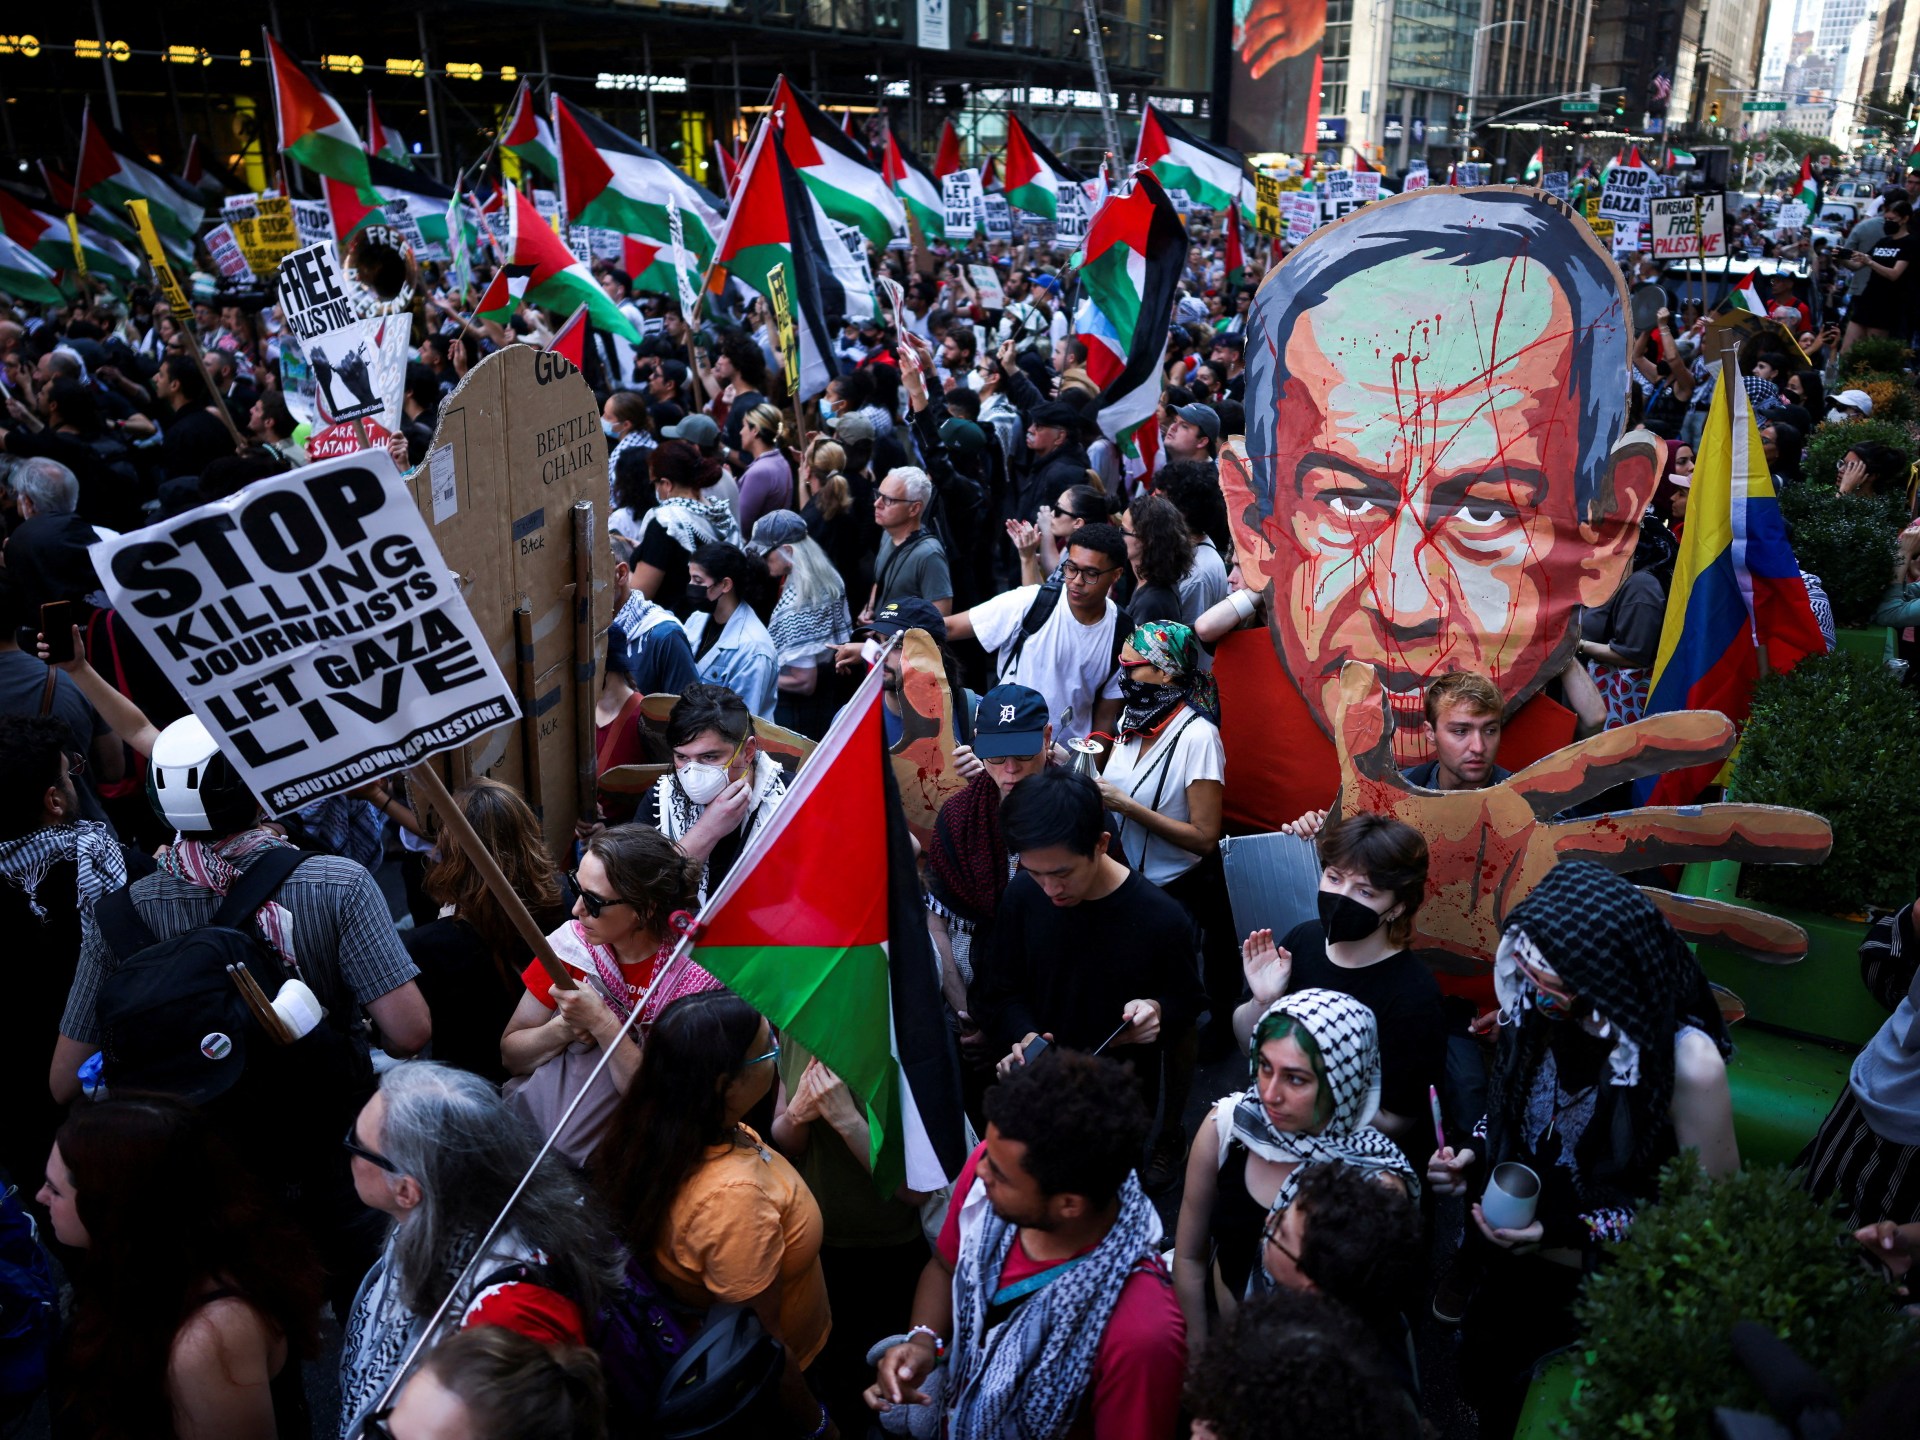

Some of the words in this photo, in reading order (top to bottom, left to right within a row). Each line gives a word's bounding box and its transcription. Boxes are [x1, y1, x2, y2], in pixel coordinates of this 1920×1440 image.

[945, 185, 971, 198] LET
[1331, 180, 1353, 192] STOP
[1605, 184, 1646, 195] STARVING
[1608, 169, 1649, 187] STOP
[946, 211, 971, 227] LIVE
[1602, 194, 1641, 213] GAZA
[1656, 199, 1693, 216] KOREANS
[1705, 198, 1715, 212] A
[365, 226, 410, 260] FREE
[280, 245, 343, 315] FREE
[288, 296, 357, 342] PALESTINE
[536, 410, 598, 458] BEETLE
[542, 442, 594, 486] CHAIR
[110, 467, 386, 619] STOP
[153, 533, 425, 662] KILLING
[186, 571, 438, 687] JOURNALISTS
[204, 664, 304, 732] LET
[313, 608, 465, 690] GAZA
[228, 640, 487, 769] LIVE
[272, 702, 506, 809] #SHUTITDOWN4PALESTINE
